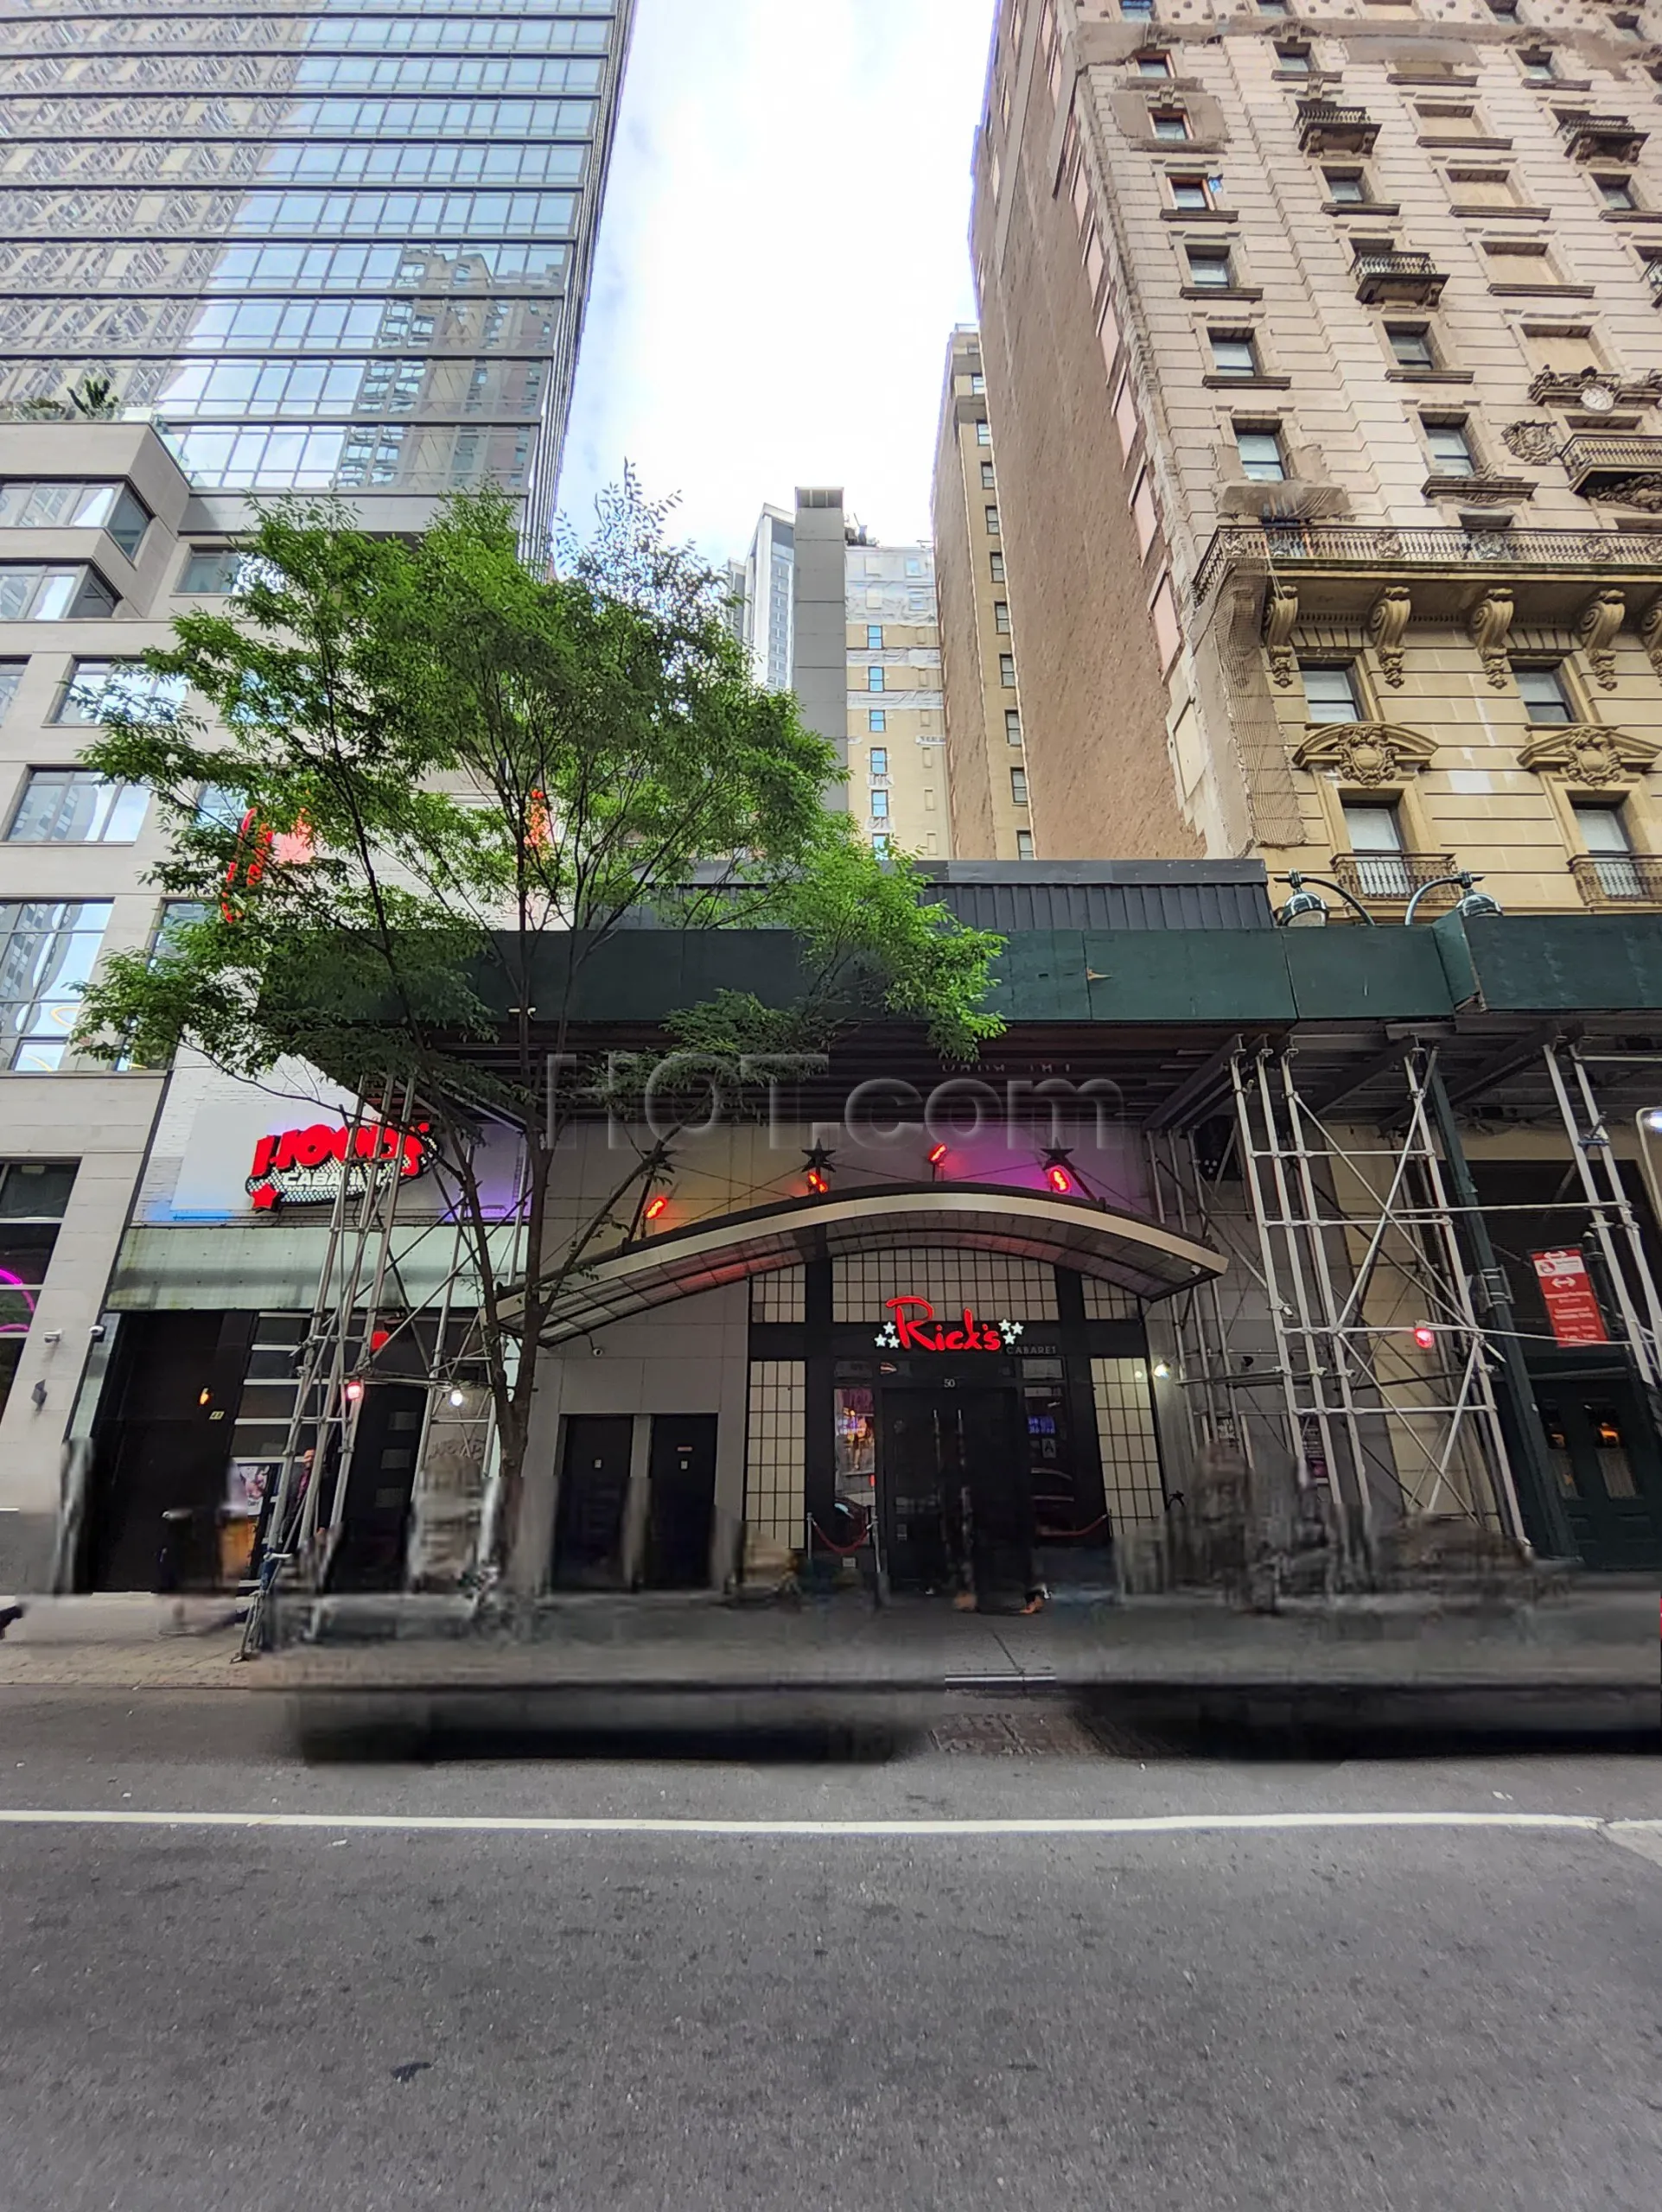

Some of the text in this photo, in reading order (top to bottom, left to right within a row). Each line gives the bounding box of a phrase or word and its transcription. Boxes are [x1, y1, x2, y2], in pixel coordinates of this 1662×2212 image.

[885, 1295, 1001, 1351] Rick's
[1006, 1345, 1057, 1355] CABARET
[943, 1378, 956, 1388] 50
